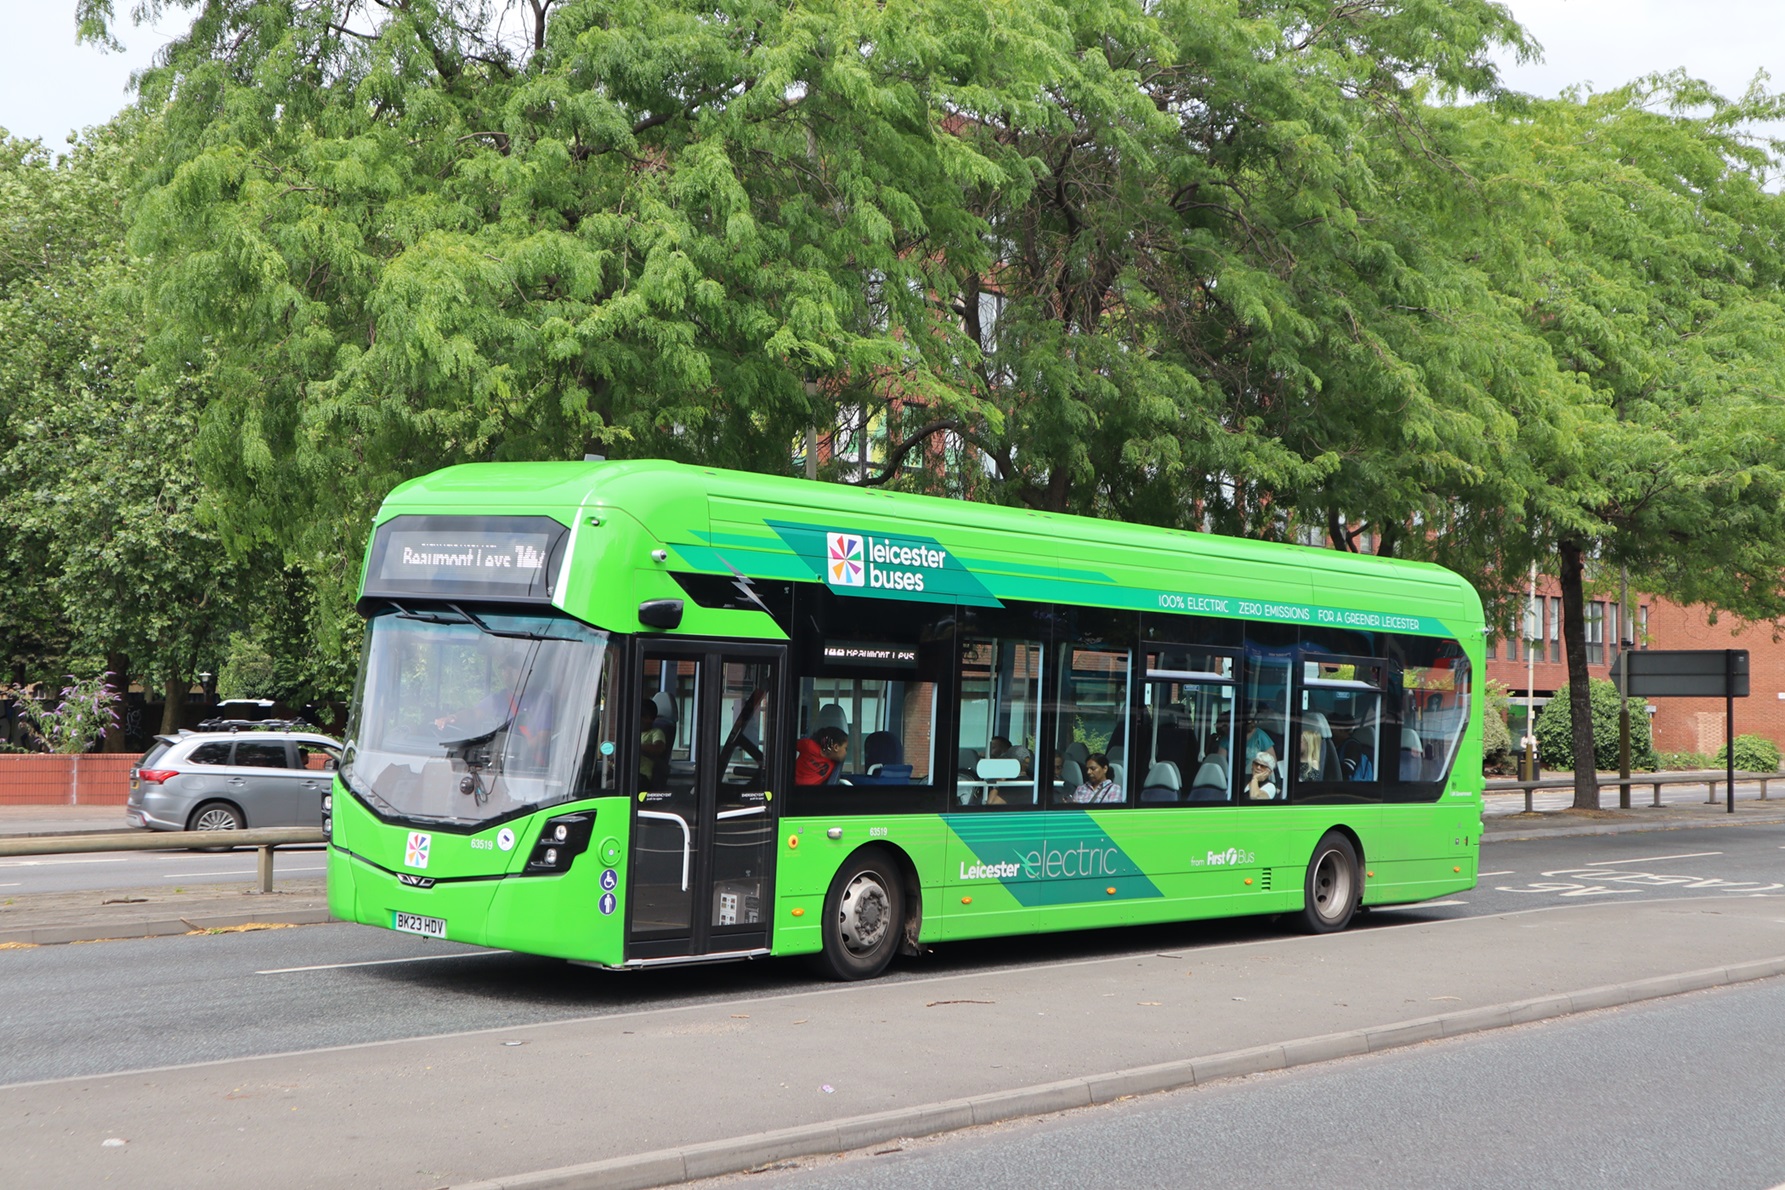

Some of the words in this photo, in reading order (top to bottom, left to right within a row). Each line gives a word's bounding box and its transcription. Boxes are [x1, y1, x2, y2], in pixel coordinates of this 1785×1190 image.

[868, 536, 946, 569] leicester
[869, 563, 925, 592] buses
[1158, 594, 1185, 609] 100%
[1187, 596, 1229, 613] ELECTRIC
[1238, 601, 1263, 616] ZERO
[1264, 604, 1310, 620] EMISSIONS
[1318, 609, 1335, 622] FOR
[1336, 611, 1343, 623] A
[1344, 612, 1380, 626] GREENER
[1381, 616, 1420, 630] LEICESTER
[870, 827, 888, 837] 63519
[471, 838, 494, 850] 63519
[1024, 838, 1118, 879] electric
[1190, 855, 1205, 867] from
[1206, 850, 1226, 866] First
[1237, 849, 1255, 864] Bus
[959, 860, 1020, 880] Leicester
[397, 913, 422, 931] BK23
[424, 918, 444, 935] HDV
